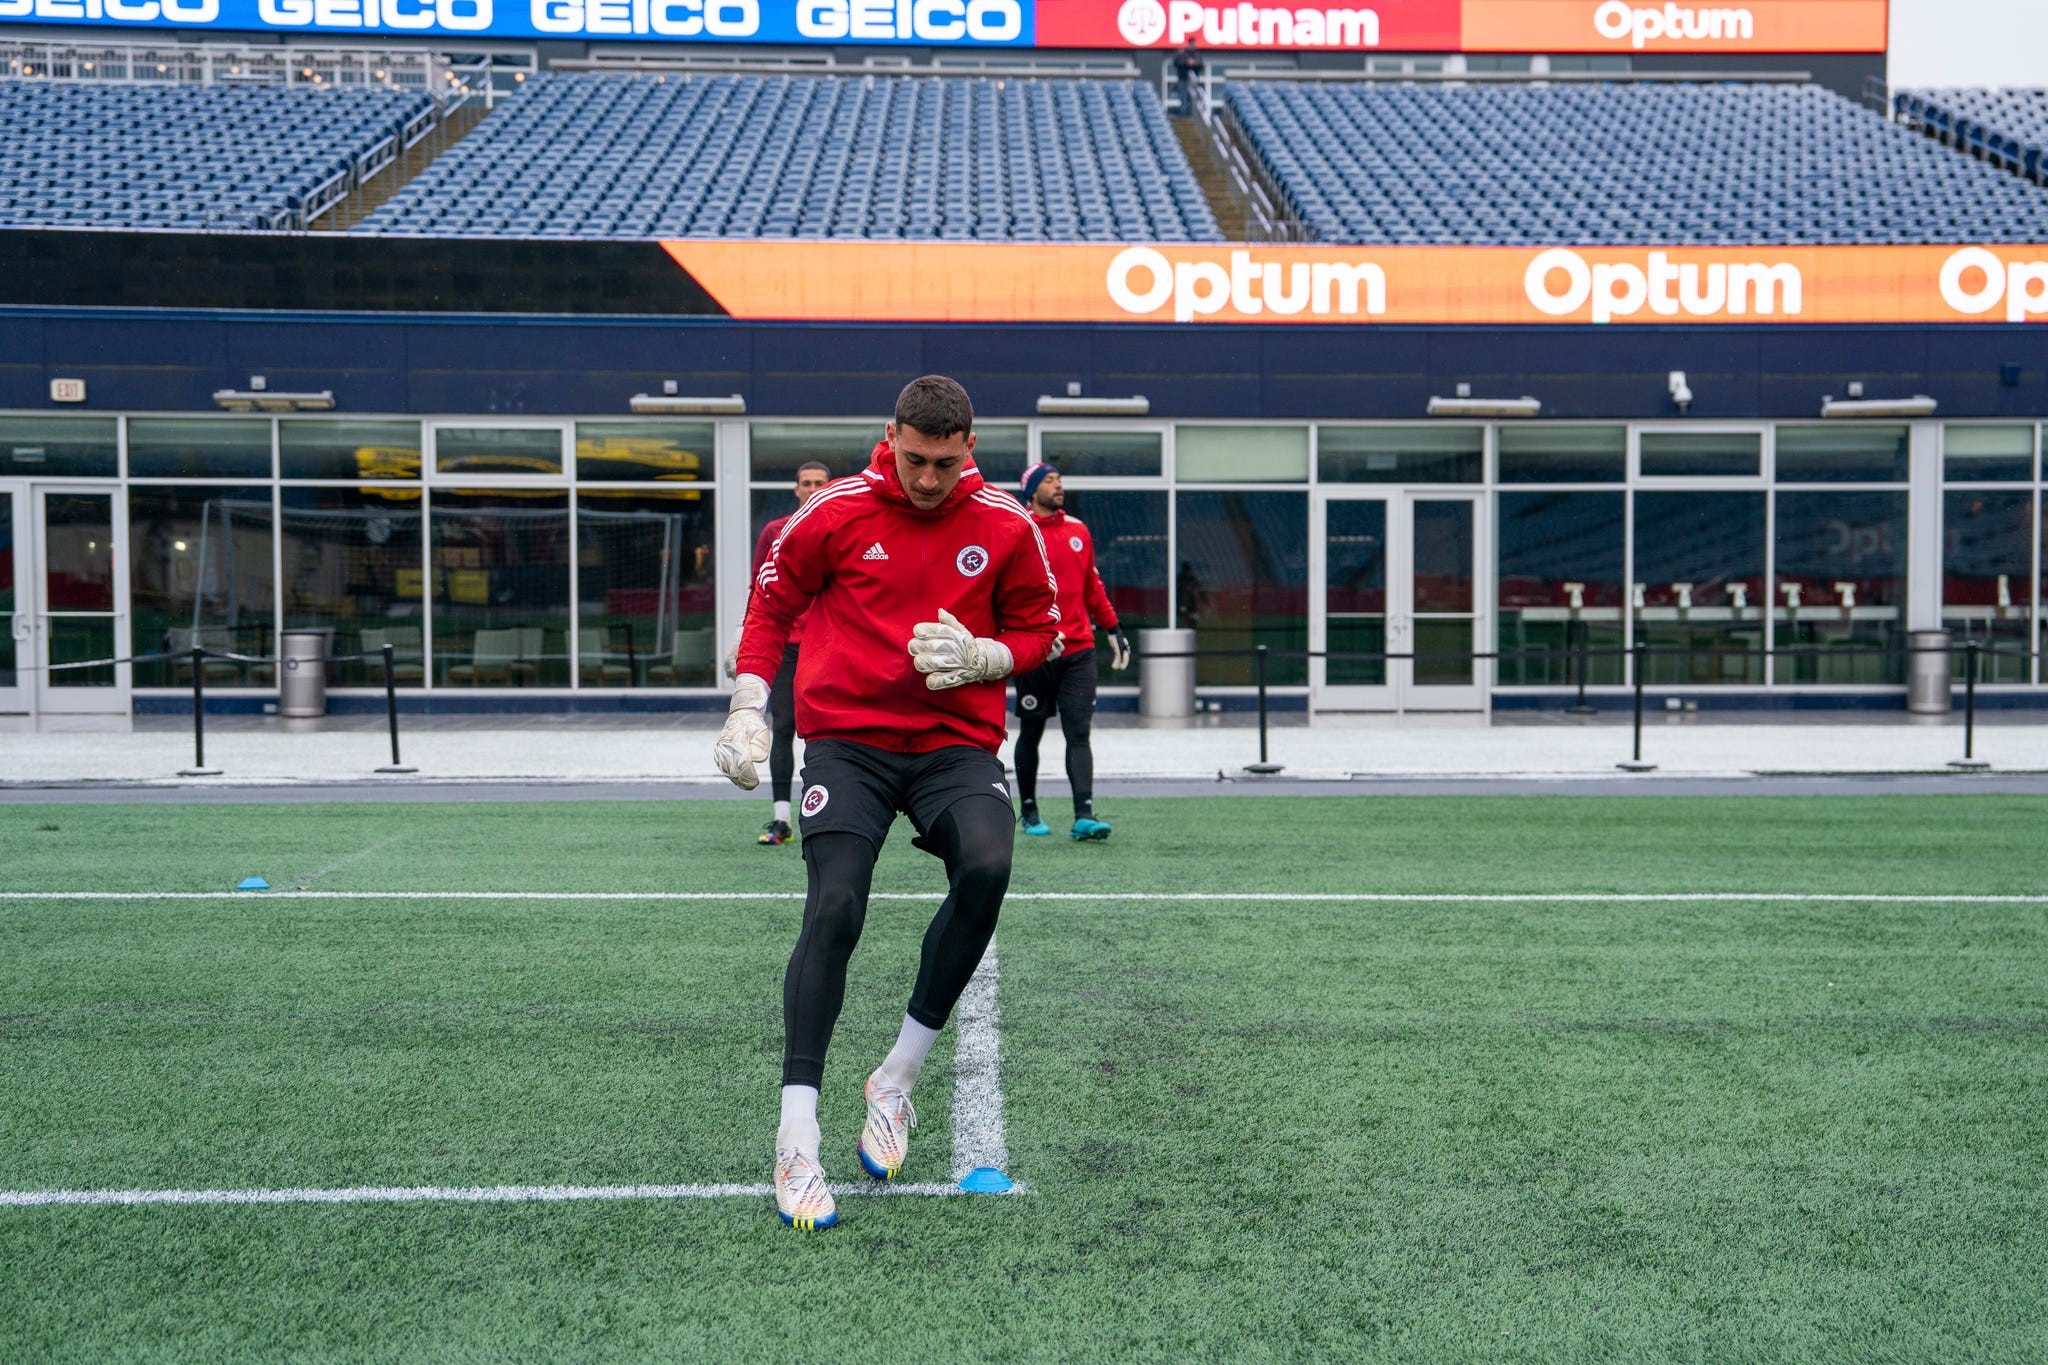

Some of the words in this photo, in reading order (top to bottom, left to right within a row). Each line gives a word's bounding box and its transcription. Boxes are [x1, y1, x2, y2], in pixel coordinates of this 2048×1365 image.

[259, 0, 492, 29] GEICO
[531, 0, 759, 36] GEICO
[797, 0, 1021, 40] GEICO
[1170, 0, 1379, 46] Putnam
[1594, 0, 1753, 49] Optum
[1106, 246, 1386, 322] Optum
[1524, 248, 1802, 323] Optum
[863, 552, 889, 560] adidas
